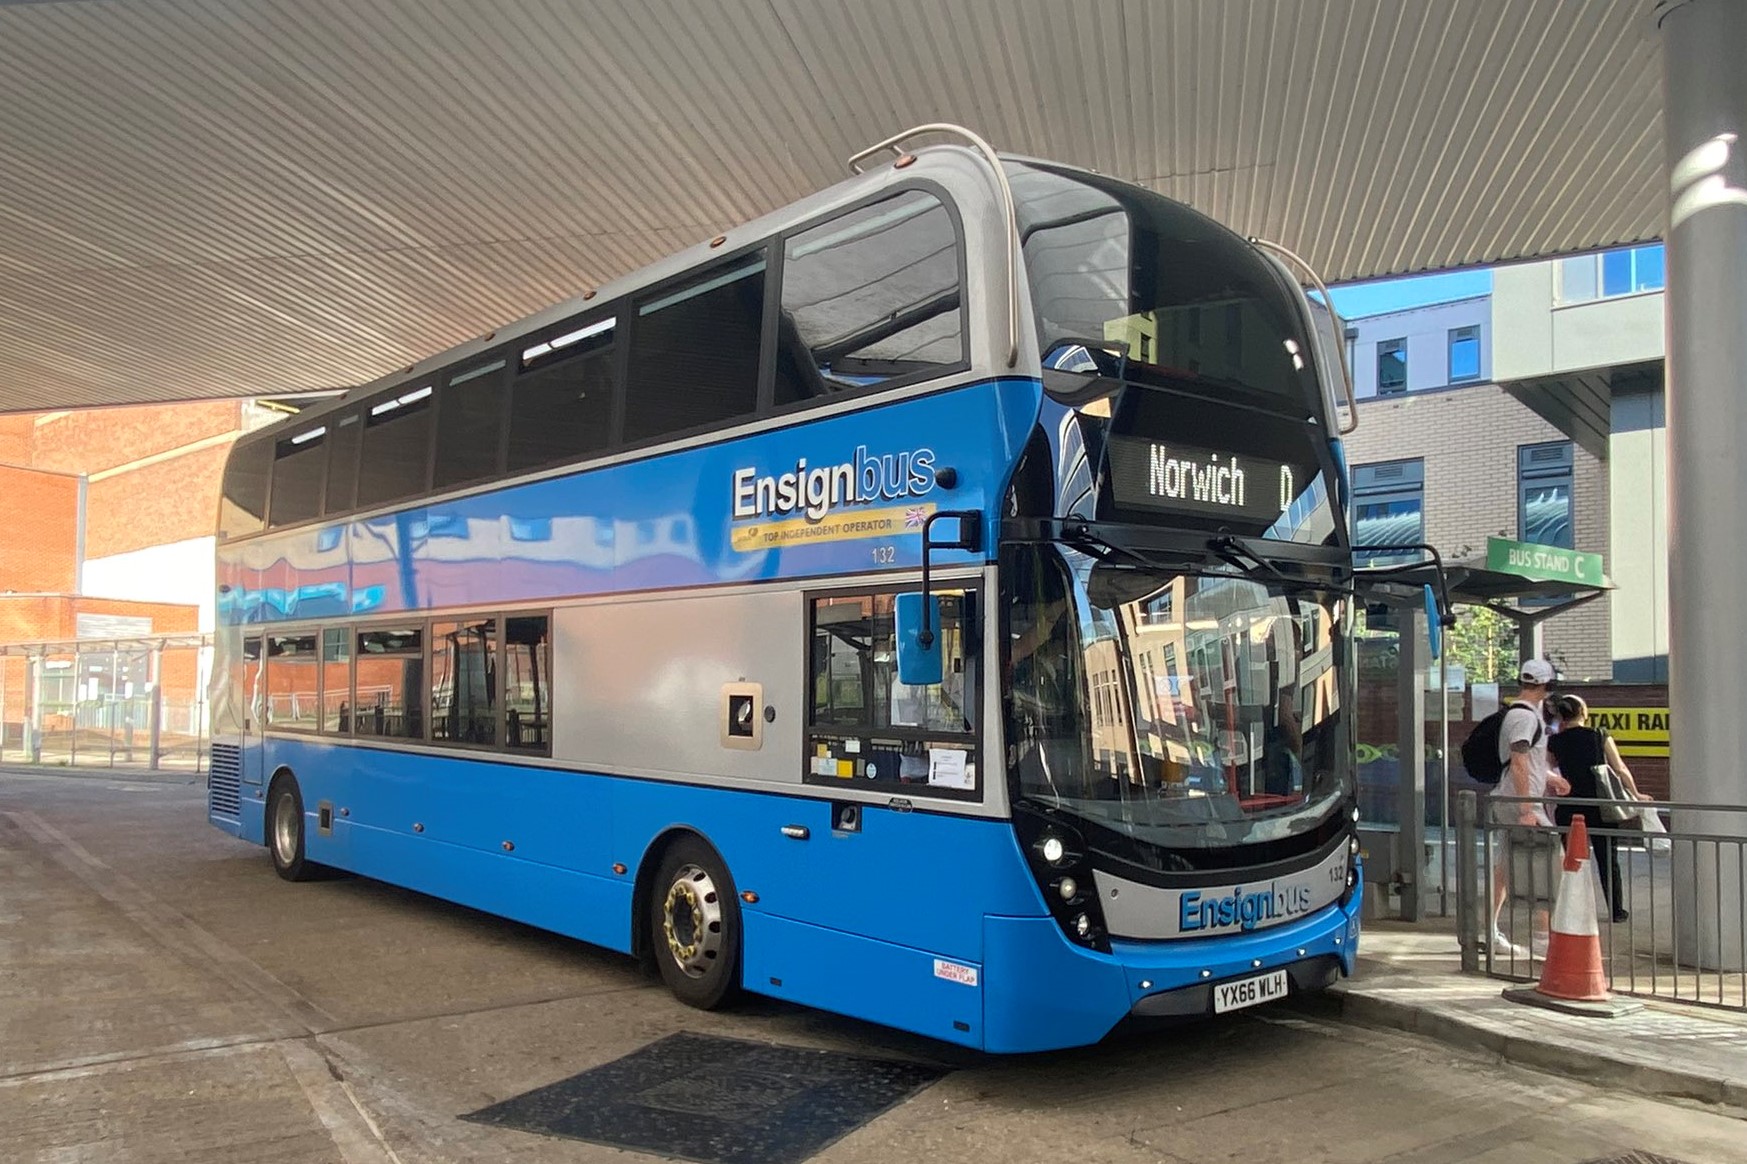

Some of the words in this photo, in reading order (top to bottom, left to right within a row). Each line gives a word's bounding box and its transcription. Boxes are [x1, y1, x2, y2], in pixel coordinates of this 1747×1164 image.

[733, 445, 936, 521] Ensignbus
[1150, 444, 1244, 506] Norwich
[1280, 465, 1293, 511] D
[763, 531, 779, 542] TOP
[781, 524, 841, 541] INDEPENDENT
[843, 518, 893, 533] OPERATOR
[872, 546, 895, 564] 132
[1508, 548, 1532, 568] BUS
[1533, 552, 1570, 572] STAND
[1574, 556, 1585, 578] C
[1588, 713, 1630, 730] TAXI
[1328, 864, 1344, 883] 132
[1179, 881, 1312, 932] Ensignbus
[936, 968, 957, 978] UNDER
[958, 973, 975, 983] FLAP
[941, 962, 969, 973] BATTERY
[1220, 982, 1255, 1005] YX66
[1259, 976, 1283, 999] WLH
